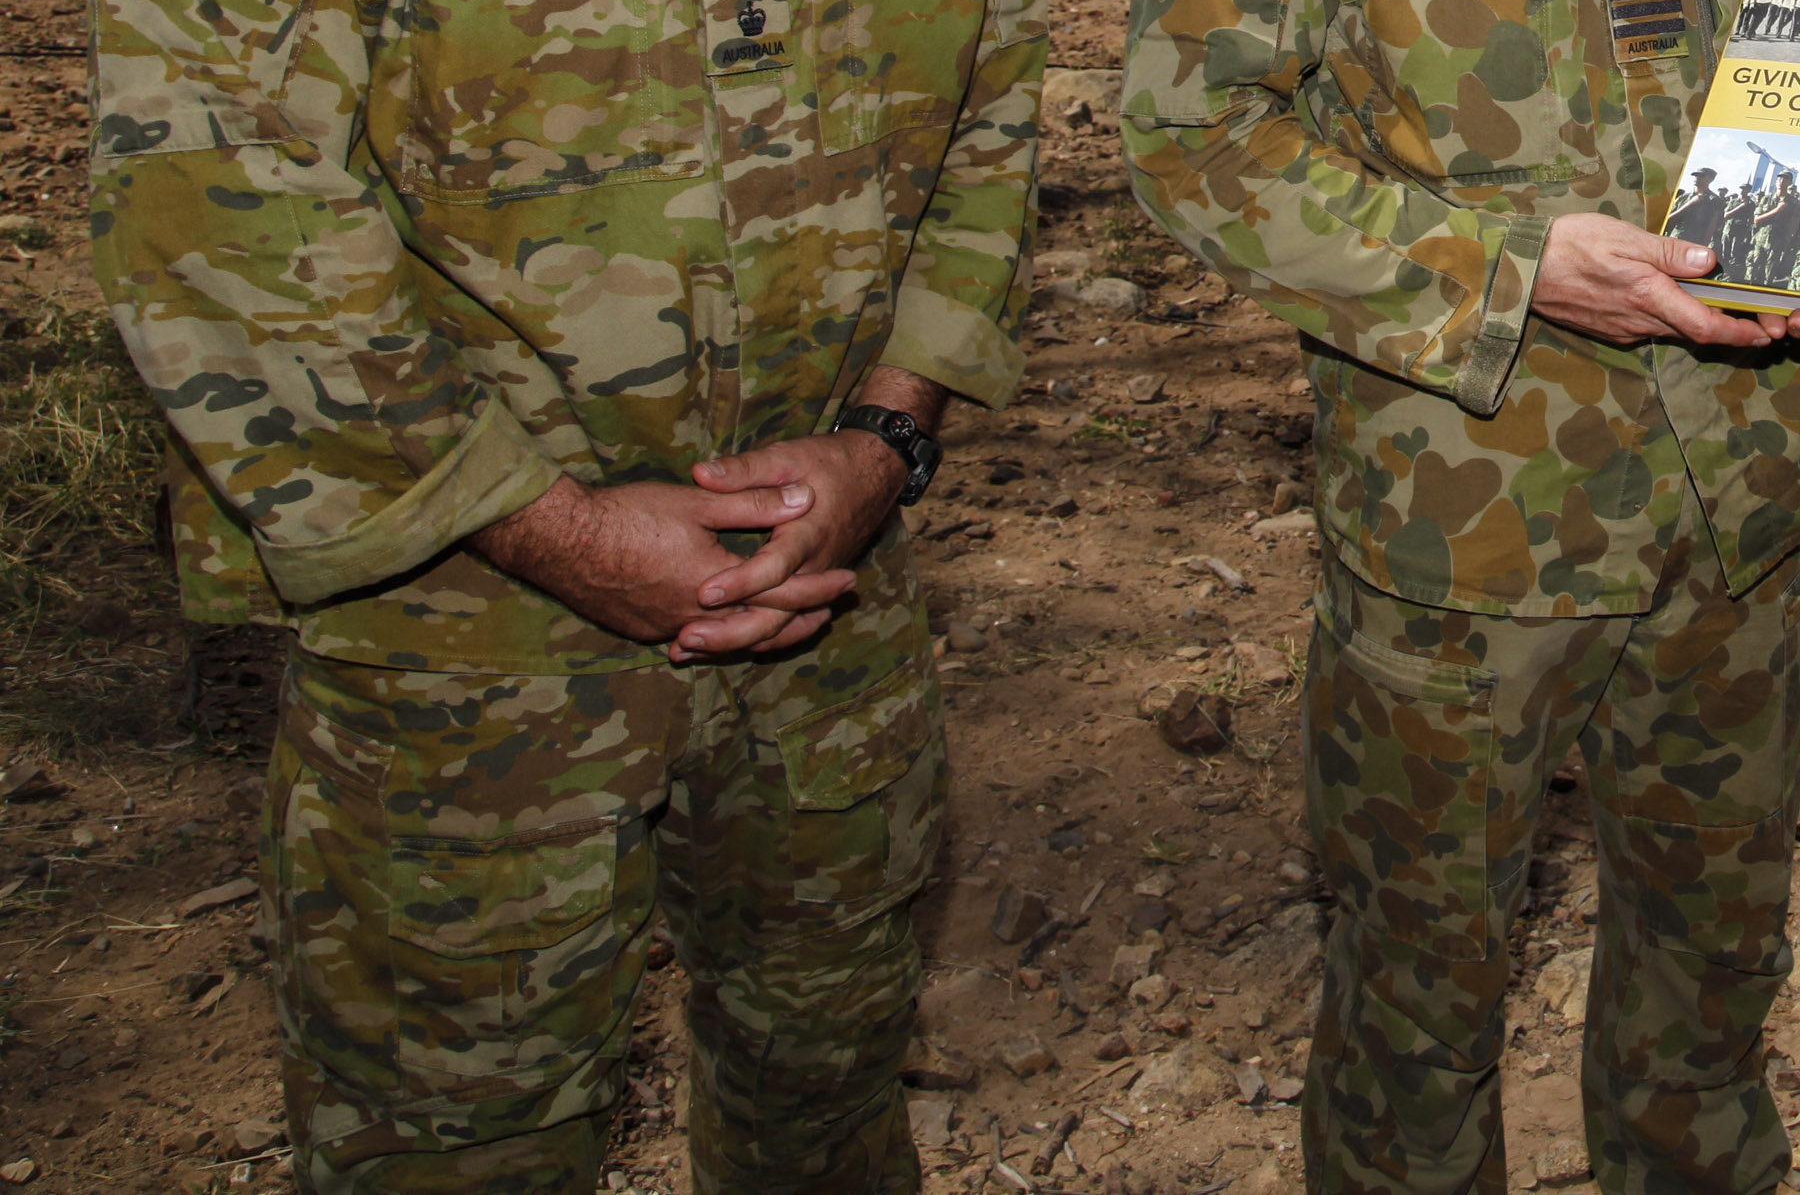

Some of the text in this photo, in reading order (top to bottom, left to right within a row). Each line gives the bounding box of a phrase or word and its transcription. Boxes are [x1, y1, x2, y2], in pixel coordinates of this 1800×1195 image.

[722, 41, 785, 63] AUSTRALIA
[1628, 38, 1679, 54] AUSTRALIA
[1746, 90, 1782, 109] TO
